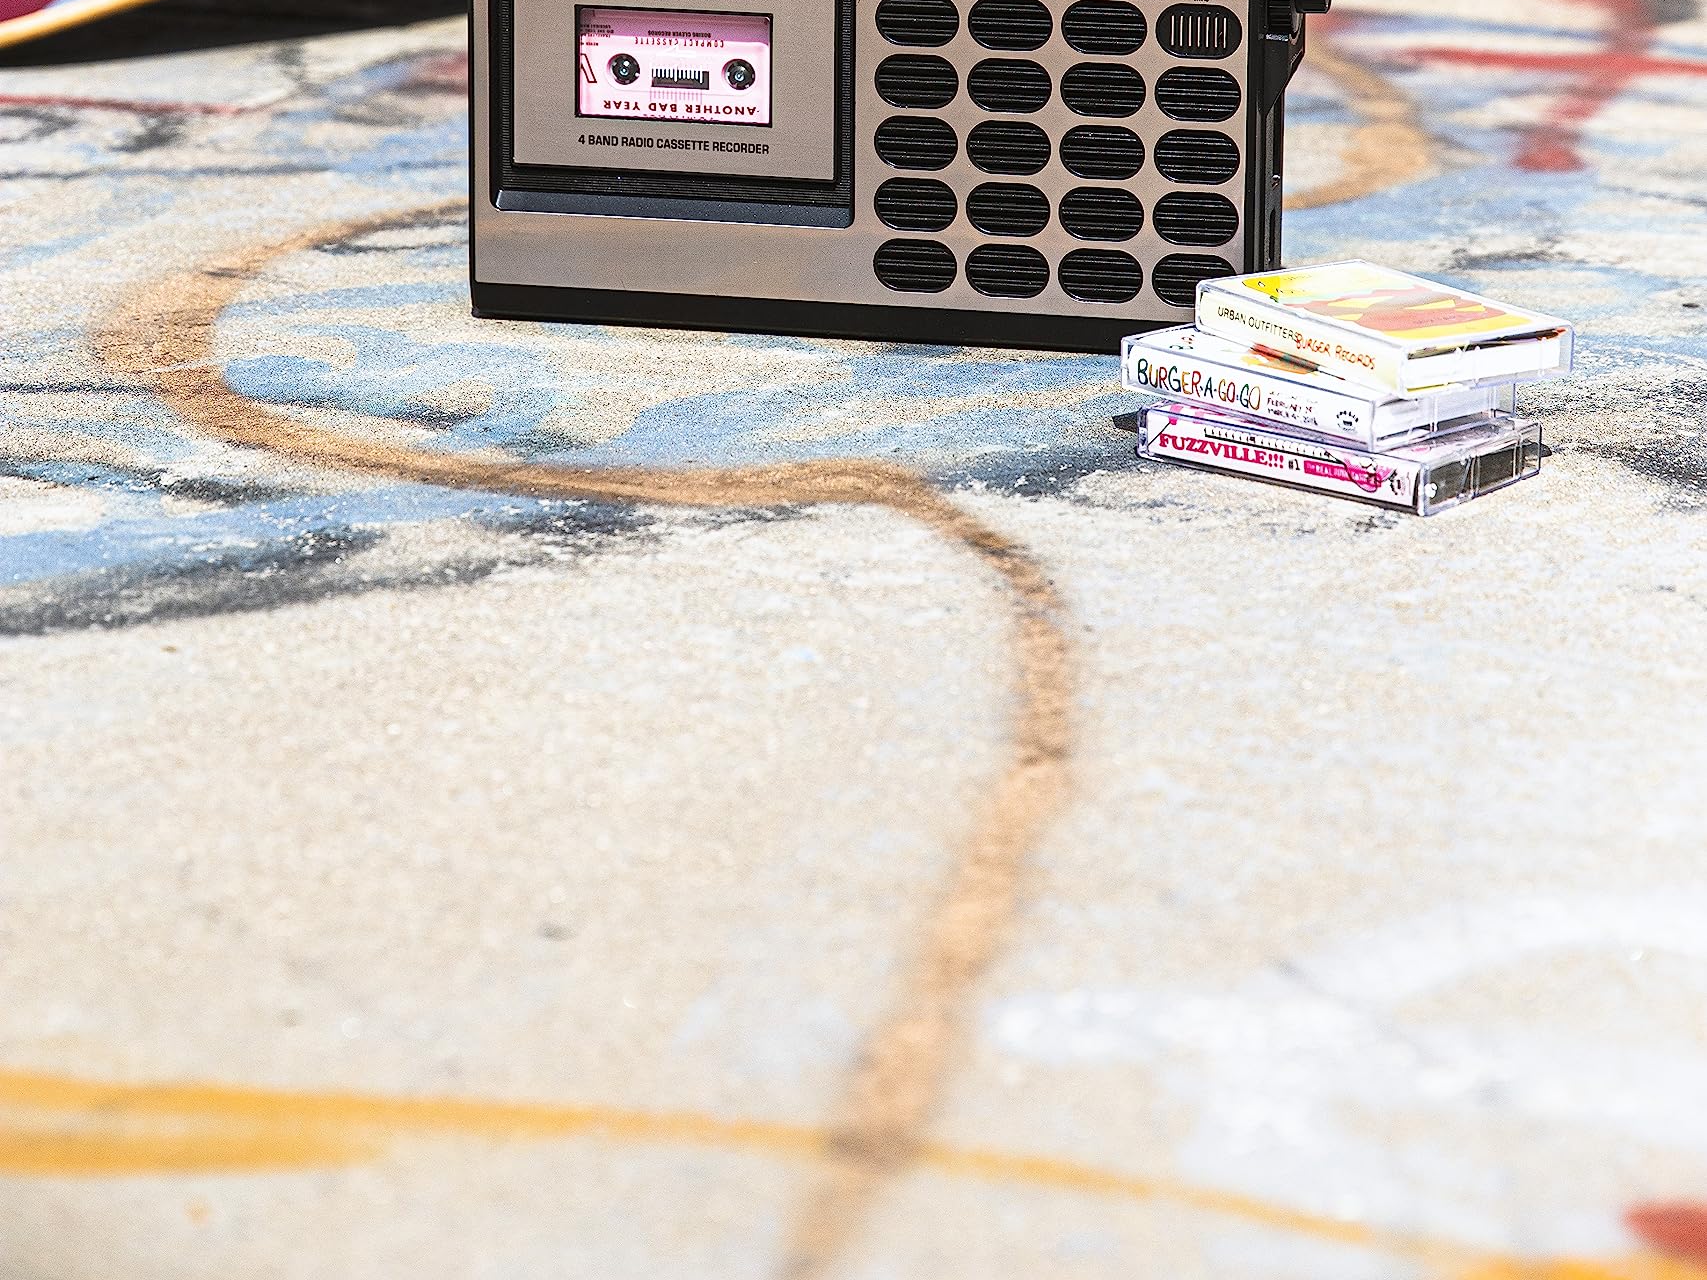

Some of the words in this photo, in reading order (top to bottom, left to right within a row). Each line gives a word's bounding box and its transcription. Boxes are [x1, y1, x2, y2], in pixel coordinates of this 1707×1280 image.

[647, 29, 672, 37] RECORDS
[635, 36, 679, 46] CASSETTE
[683, 39, 724, 48] COMPACT
[603, 100, 640, 111] YEAR
[648, 102, 678, 113] BAD
[685, 104, 757, 116] ANOTHER
[578, 134, 586, 145] 4
[588, 134, 619, 147] BAND
[621, 136, 654, 148] RADIO
[656, 138, 710, 152] CASSETTE
[712, 141, 770, 155] RECORDER
[1217, 306, 1246, 325] URBAN
[1248, 316, 1299, 342] OUTFITTERS
[1295, 331, 1331, 356] BURGER
[1159, 433, 1284, 469] FUZZVILLE!!!
